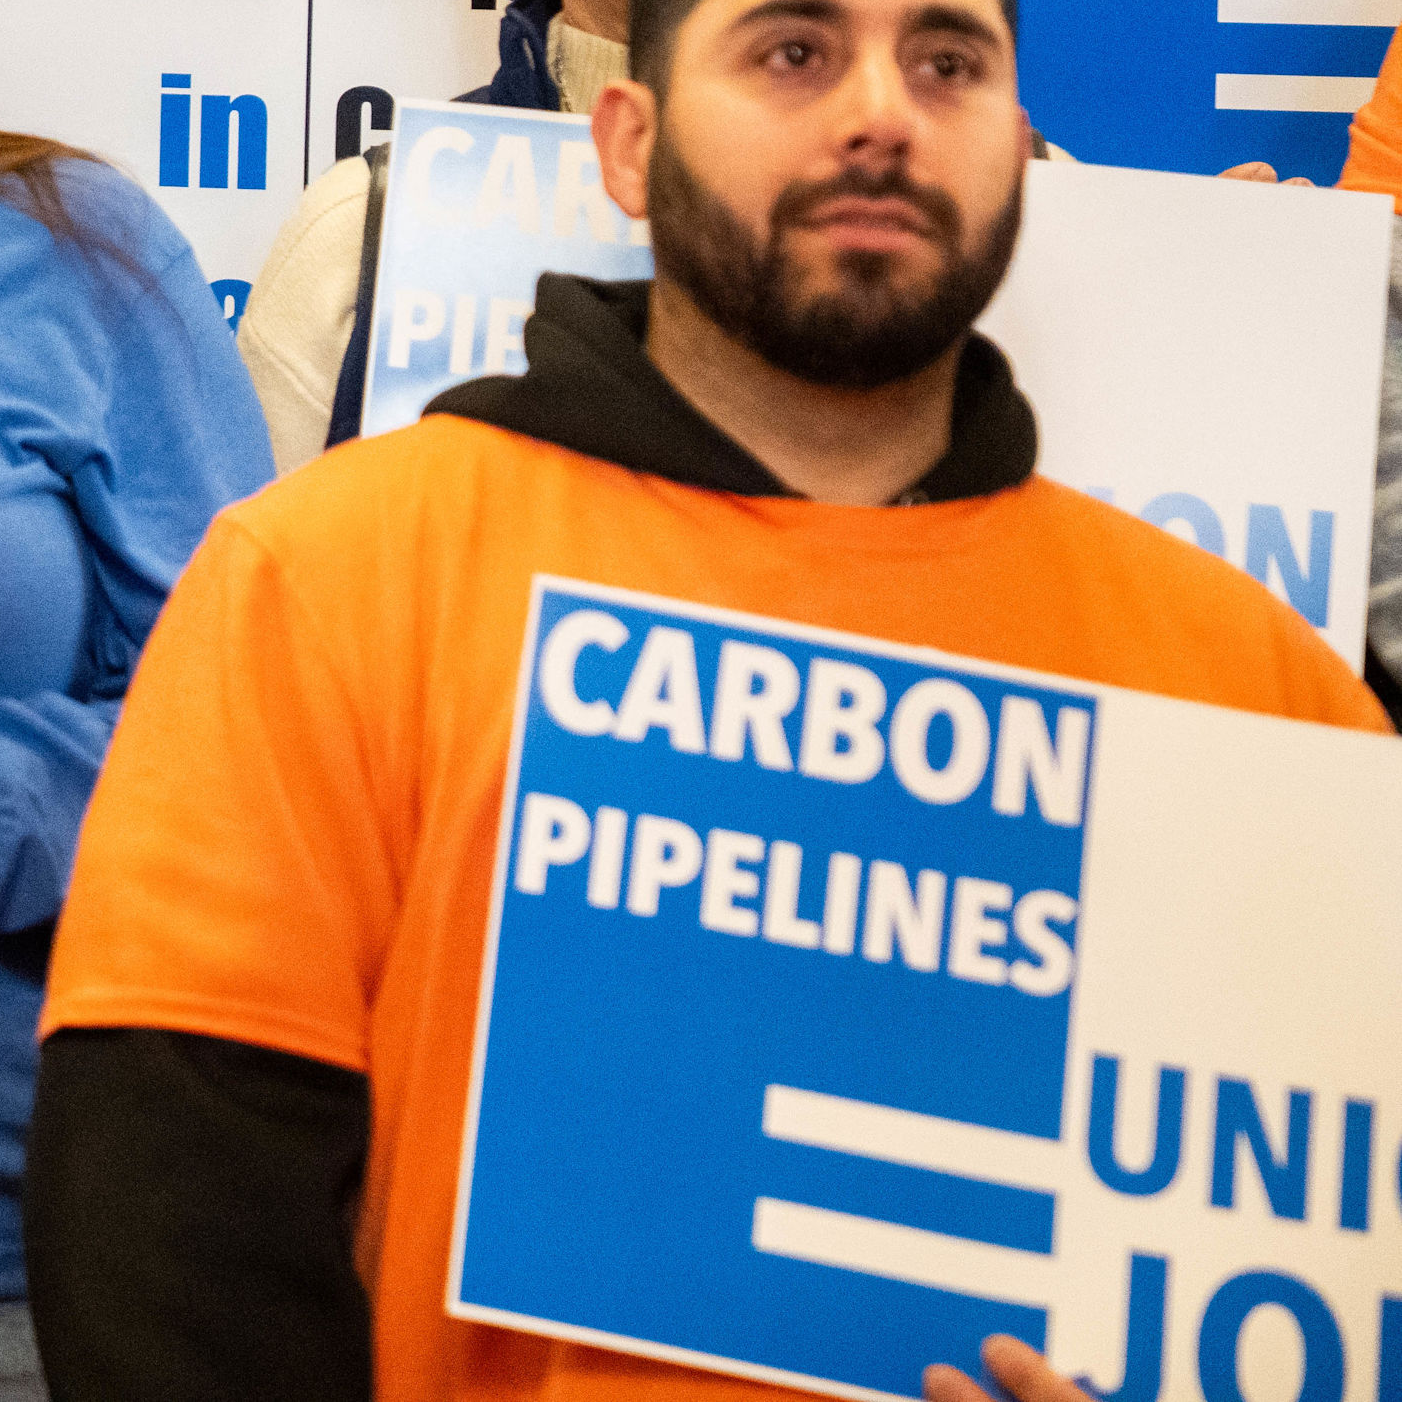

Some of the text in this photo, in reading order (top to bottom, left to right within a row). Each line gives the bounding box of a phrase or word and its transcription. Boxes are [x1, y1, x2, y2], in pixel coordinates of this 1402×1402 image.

[158, 72, 269, 192] in
[403, 125, 650, 247] CAR
[538, 609, 1093, 828] CARBON
[514, 791, 1081, 998] PIPELINES
[1086, 1051, 1402, 1234] UNI
[1073, 1249, 1402, 1402] JO
